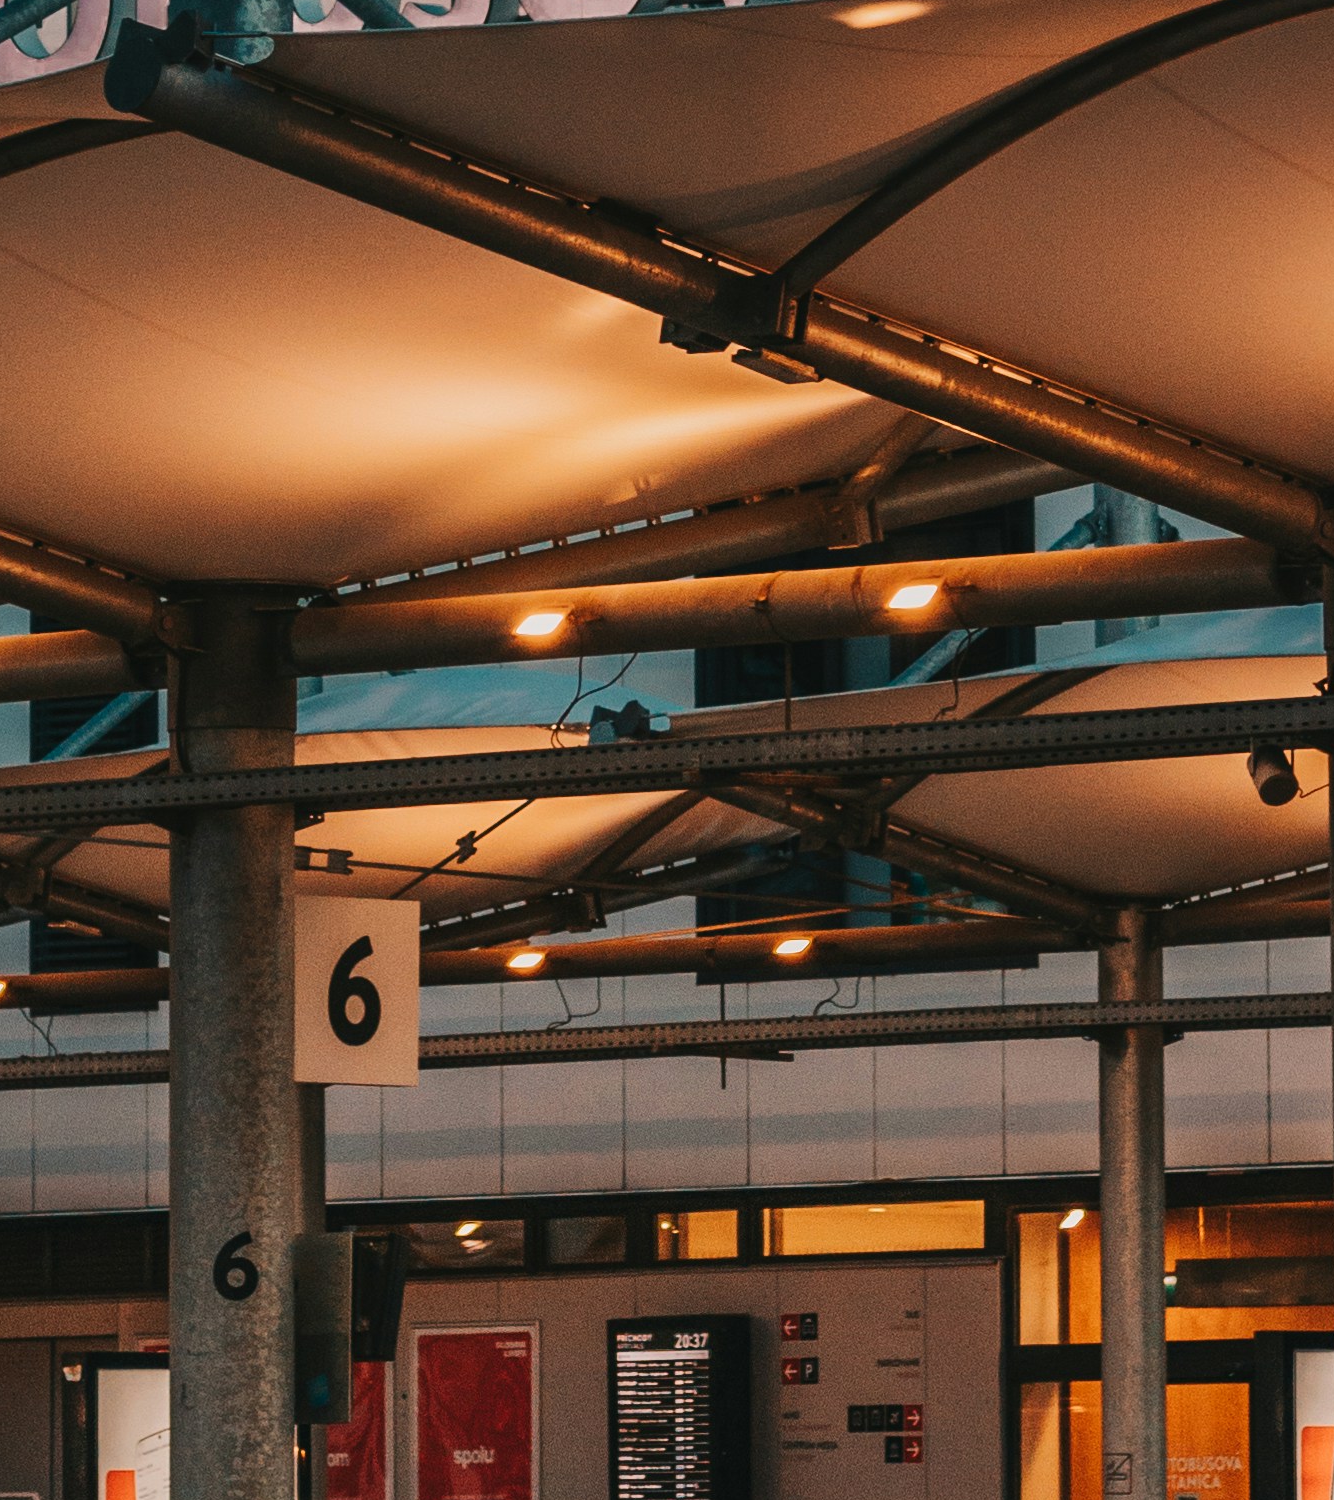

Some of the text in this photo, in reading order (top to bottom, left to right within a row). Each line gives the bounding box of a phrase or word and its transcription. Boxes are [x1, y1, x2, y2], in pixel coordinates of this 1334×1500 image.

[328, 936, 381, 1046] 6
[213, 1231, 259, 1301] 6
[674, 1332, 709, 1348] 20:37
[805, 1363, 813, 1379] P
[1167, 1451, 1242, 1472] TOBUSOVÁ
[1167, 1474, 1222, 1490] TANICA
